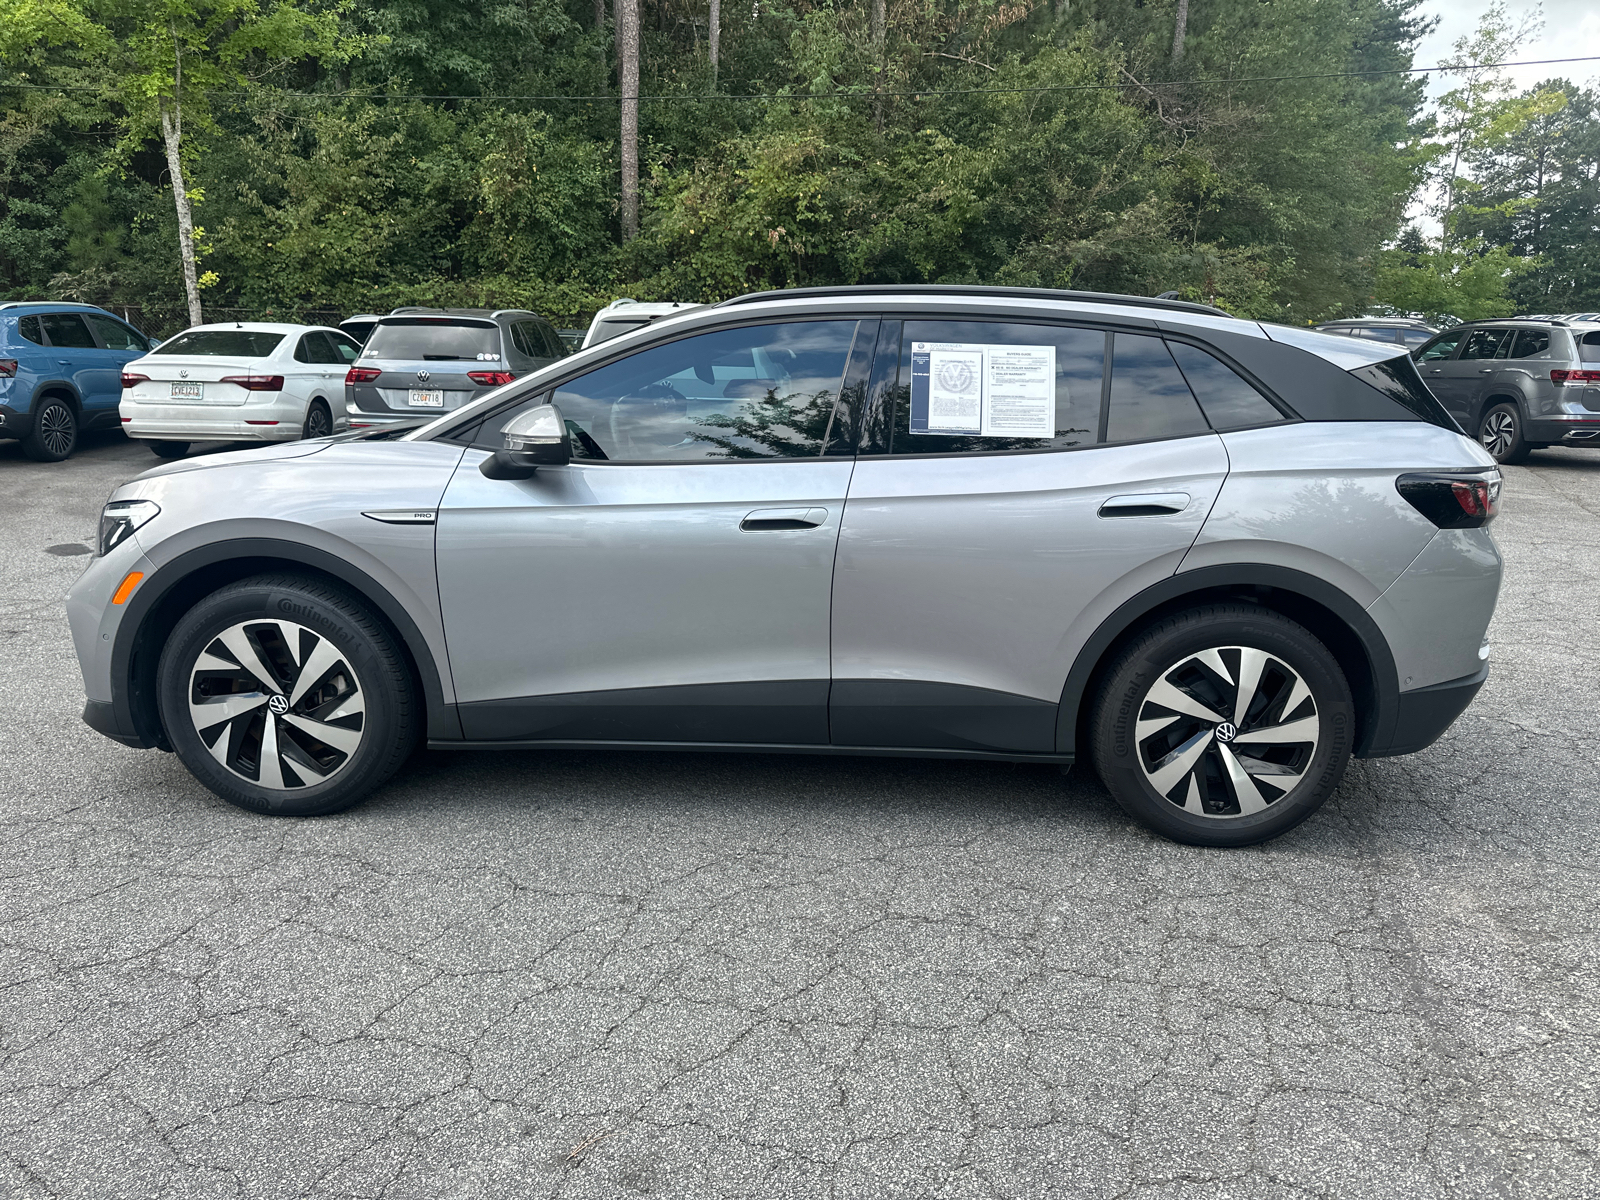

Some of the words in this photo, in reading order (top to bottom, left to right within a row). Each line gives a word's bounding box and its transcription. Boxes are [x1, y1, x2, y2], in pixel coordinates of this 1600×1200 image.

[276, 598, 355, 646] Continental
[1112, 680, 1142, 758] Continental
[1319, 711, 1348, 790] Continental
